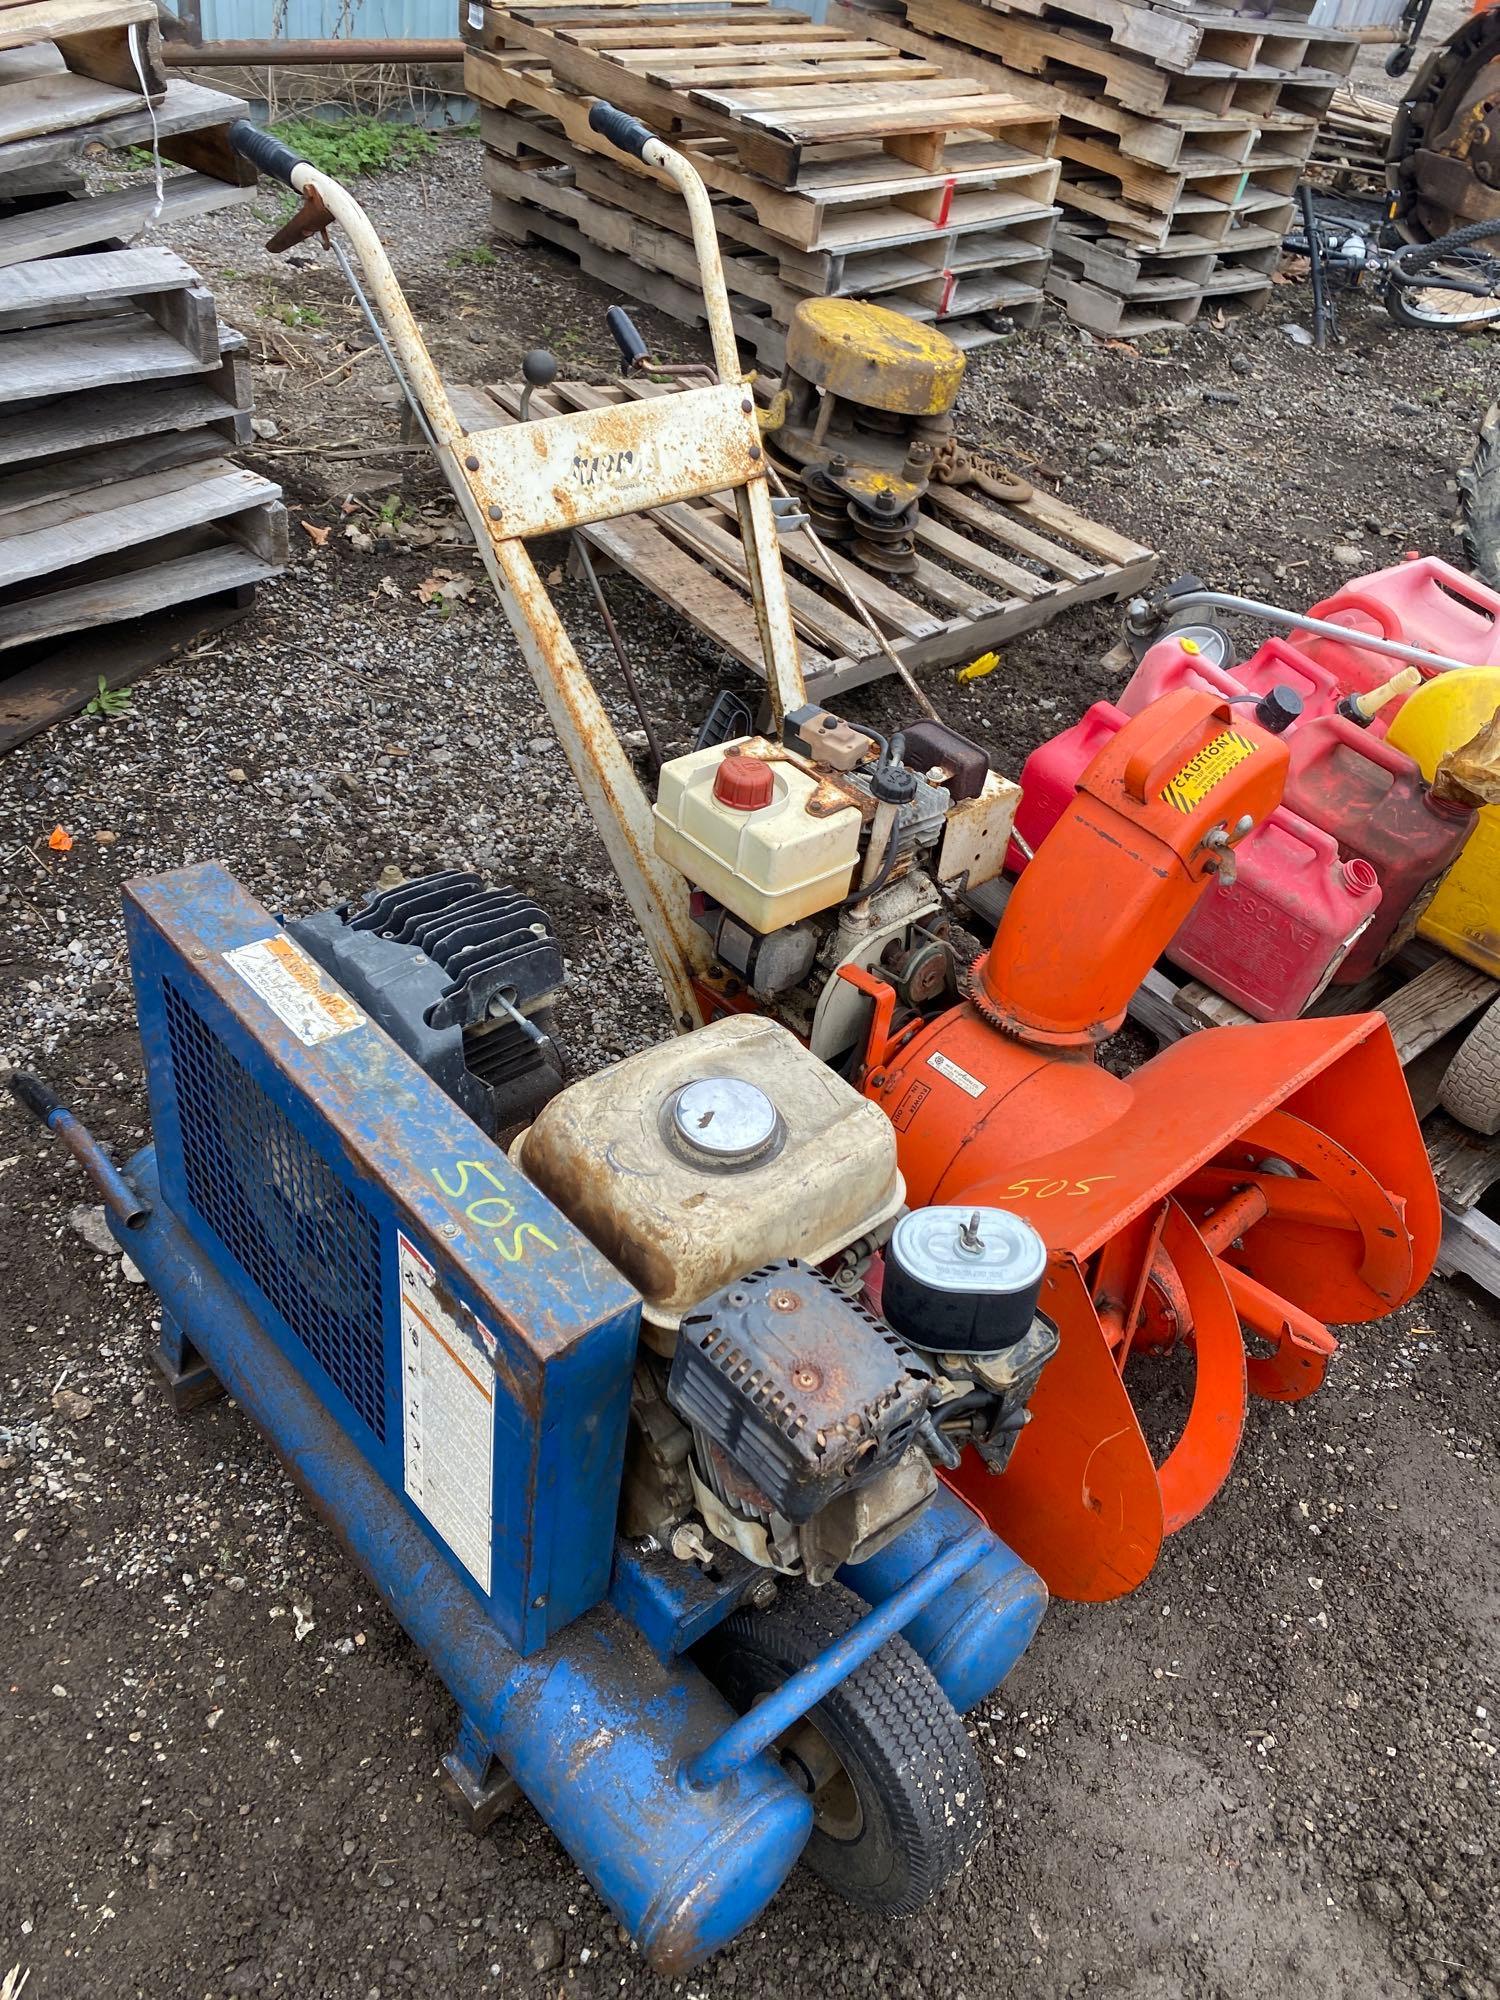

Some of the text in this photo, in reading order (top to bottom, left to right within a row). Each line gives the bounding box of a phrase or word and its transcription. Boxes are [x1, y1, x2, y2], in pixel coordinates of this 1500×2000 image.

[1175, 739, 1229, 788] CAUTION
[910, 1084, 919, 1093] IN
[910, 1087, 928, 1114] BLOWER
[999, 1175, 1117, 1200] 505
[430, 1160, 559, 1262] 505
